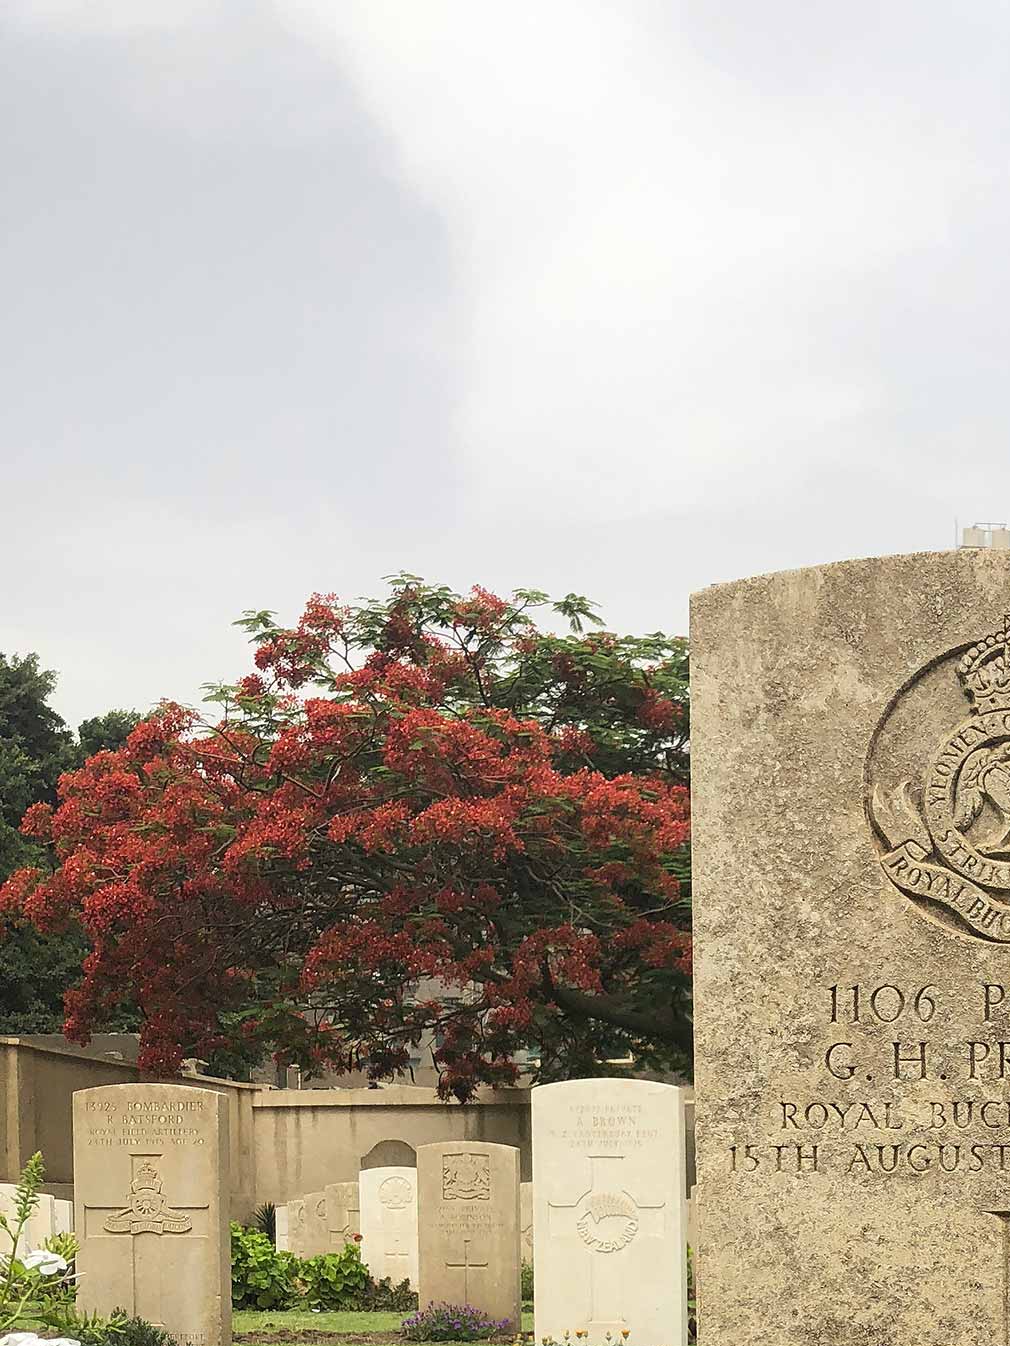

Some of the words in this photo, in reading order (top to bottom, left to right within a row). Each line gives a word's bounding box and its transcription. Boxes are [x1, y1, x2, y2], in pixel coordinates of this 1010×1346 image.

[887, 855, 968, 911] ROYAL
[827, 983, 937, 1024] 1106
[127, 1101, 205, 1112] BOMBARDIER
[779, 1101, 903, 1130] ROYAL
[592, 1115, 637, 1128] BROWN
[729, 1144, 819, 1173] 15TH
